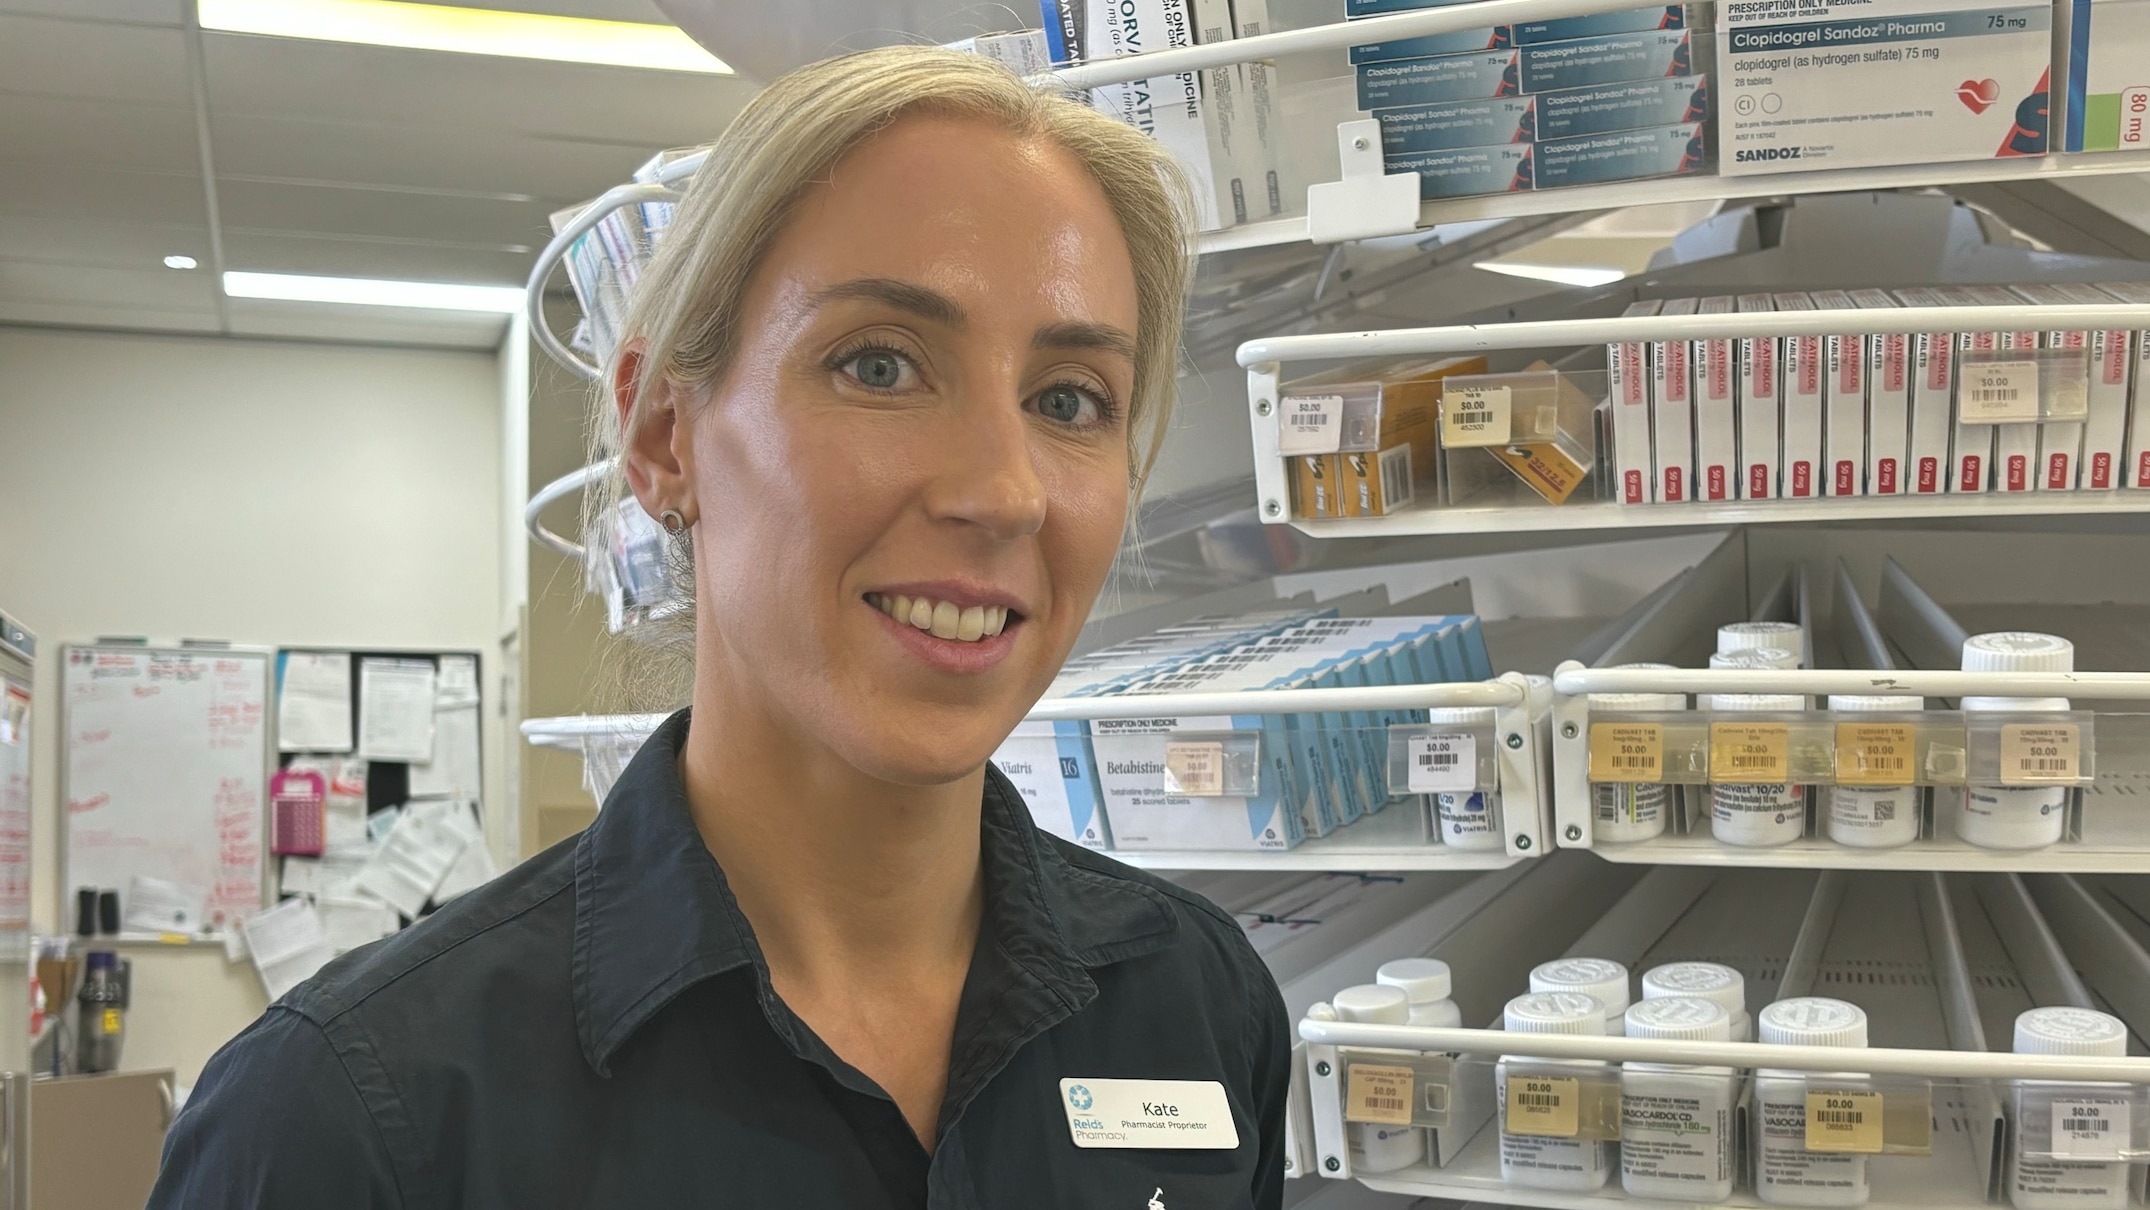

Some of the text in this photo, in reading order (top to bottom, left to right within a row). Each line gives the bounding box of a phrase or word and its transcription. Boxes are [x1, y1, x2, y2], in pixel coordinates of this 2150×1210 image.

[1728, 0, 1796, 14] PRESCRIPTION
[1728, 8, 1829, 22] KEEP OUT OF REACH OF CHILDREN
[1987, 15, 2027, 29] 75 mg
[1172, 12, 1188, 47] ONLY
[1734, 28, 1821, 48] Clopidogrel
[1887, 21, 1945, 36] Pharma
[1734, 47, 1940, 73] clopidogrel (as hydrogen sulfate) 75 mg
[1734, 77, 1773, 87] 28 tablets
[2124, 93, 2148, 143] 80 mg
[1735, 146, 1801, 162] SANDOZ
[1981, 377, 2009, 387] $0.00
[1299, 403, 1321, 412] $0.00
[1460, 400, 1485, 411] $0.00
[1530, 457, 1567, 488] 32/12.5
[1426, 743, 1450, 752] $0.00
[1621, 745, 1647, 754] $0.00
[1867, 745, 1894, 755] $0.00
[2030, 747, 2058, 756] $0.00
[1001, 761, 1033, 775] Viatris
[1062, 760, 1078, 776] 16
[1756, 784, 1785, 795] 10/20
[1374, 1086, 1397, 1096] $0.00
[1527, 1083, 1552, 1093] $0.00
[1826, 1098, 1853, 1109] $0.00
[1142, 1102, 1180, 1117] Kate
[2072, 1107, 2100, 1117] $0.00
[1679, 1112, 1693, 1122] CD
[1121, 1120, 1208, 1131] Pharmacist Proprietor
[1683, 1121, 1700, 1131] 180
